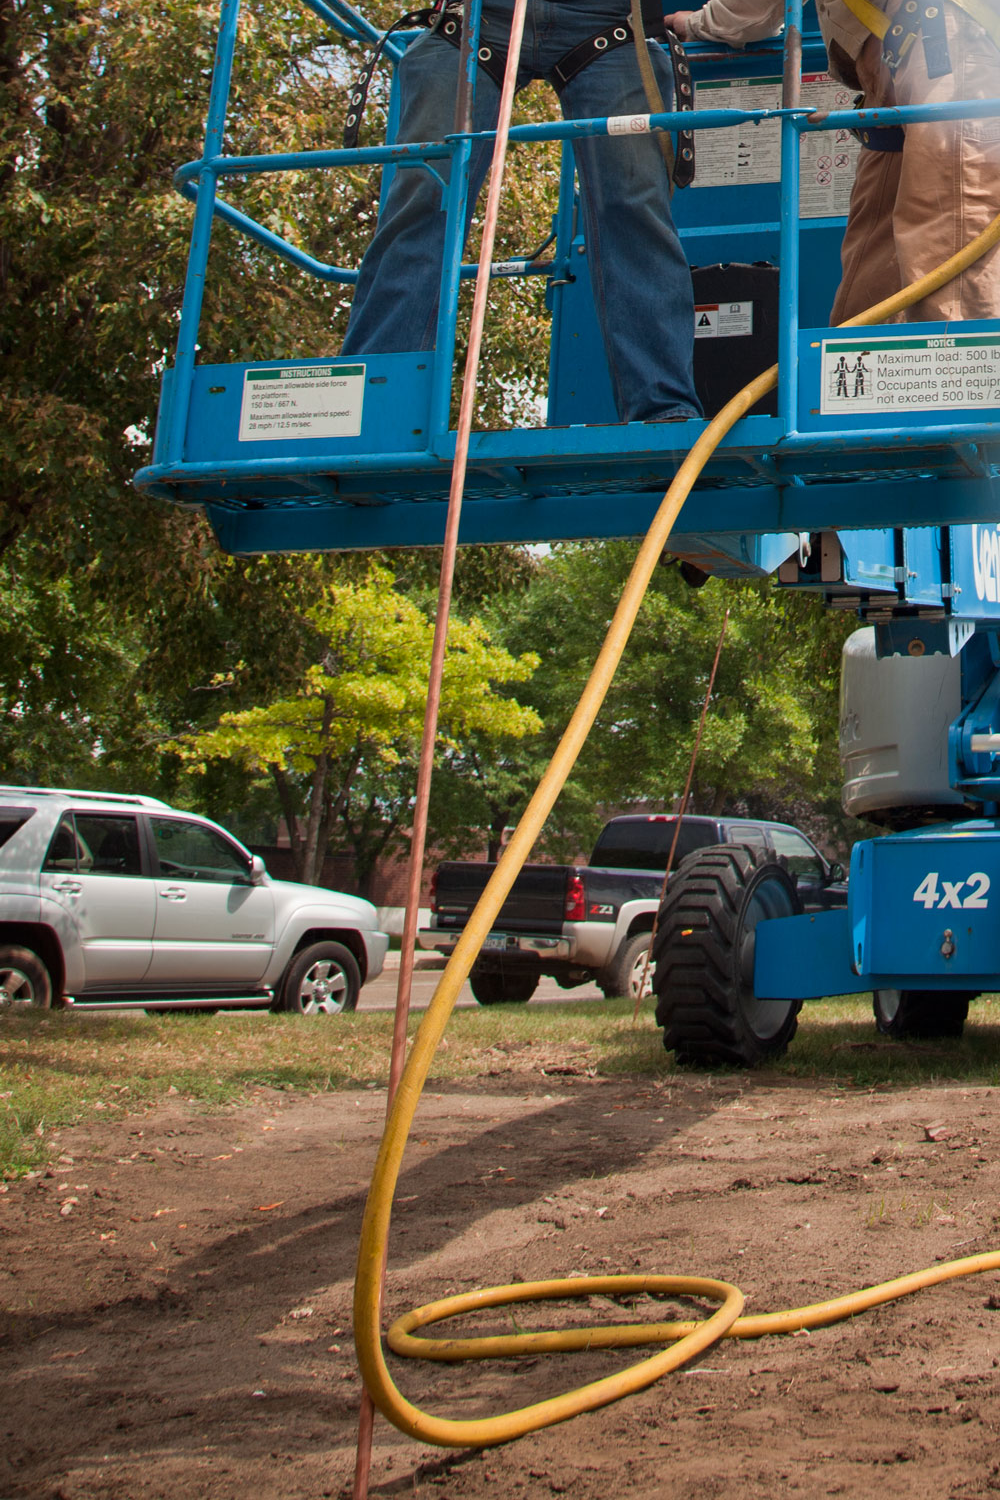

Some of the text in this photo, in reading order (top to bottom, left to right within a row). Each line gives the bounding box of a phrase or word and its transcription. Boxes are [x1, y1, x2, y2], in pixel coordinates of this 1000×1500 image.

[927, 339, 956, 348] NOTICE
[877, 354, 932, 364] Maximum
[935, 351, 962, 362] load:
[966, 350, 988, 361] 500
[280, 368, 333, 379] INSTRUCTIONS
[877, 367, 932, 378] Maximum
[935, 364, 997, 376] occupants:
[252, 383, 284, 391] Maximum
[877, 380, 938, 392] Occupants
[941, 378, 962, 388] and
[877, 394, 895, 404] not
[898, 392, 939, 403] exceed
[942, 391, 964, 402] 500
[967, 390, 984, 401] lbs
[986, 389, 991, 400] /
[329, 410, 352, 418] speed:
[257, 422, 273, 430] mph
[913, 871, 991, 909] 4x2
[590, 904, 614, 915] Z71
